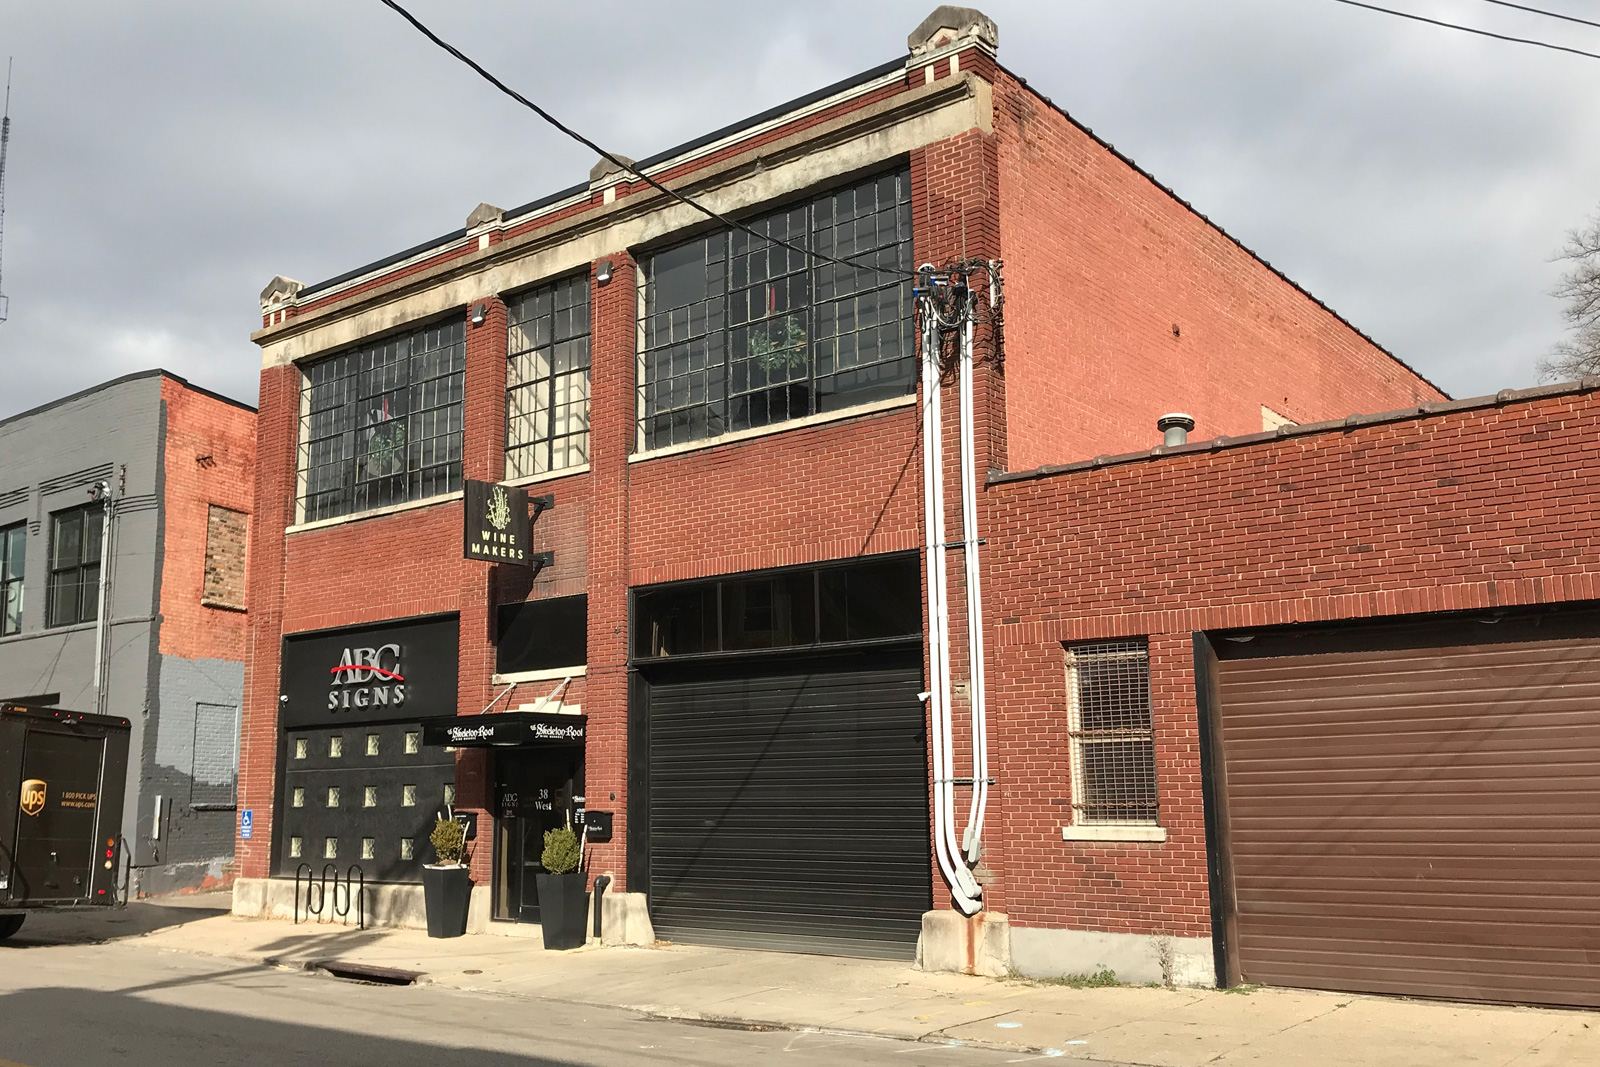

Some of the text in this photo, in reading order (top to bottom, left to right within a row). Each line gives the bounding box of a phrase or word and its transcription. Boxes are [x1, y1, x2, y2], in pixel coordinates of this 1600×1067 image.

[481, 530, 515, 545] WINE
[471, 543, 524, 560] MAKERS
[330, 643, 401, 686] ABC
[327, 684, 405, 710] SIGNS
[22, 790, 45, 810] ups
[75, 792, 87, 800] PICK
[538, 788, 549, 800] 38
[61, 800, 95, 808] www.ups.com
[534, 800, 552, 811] West
